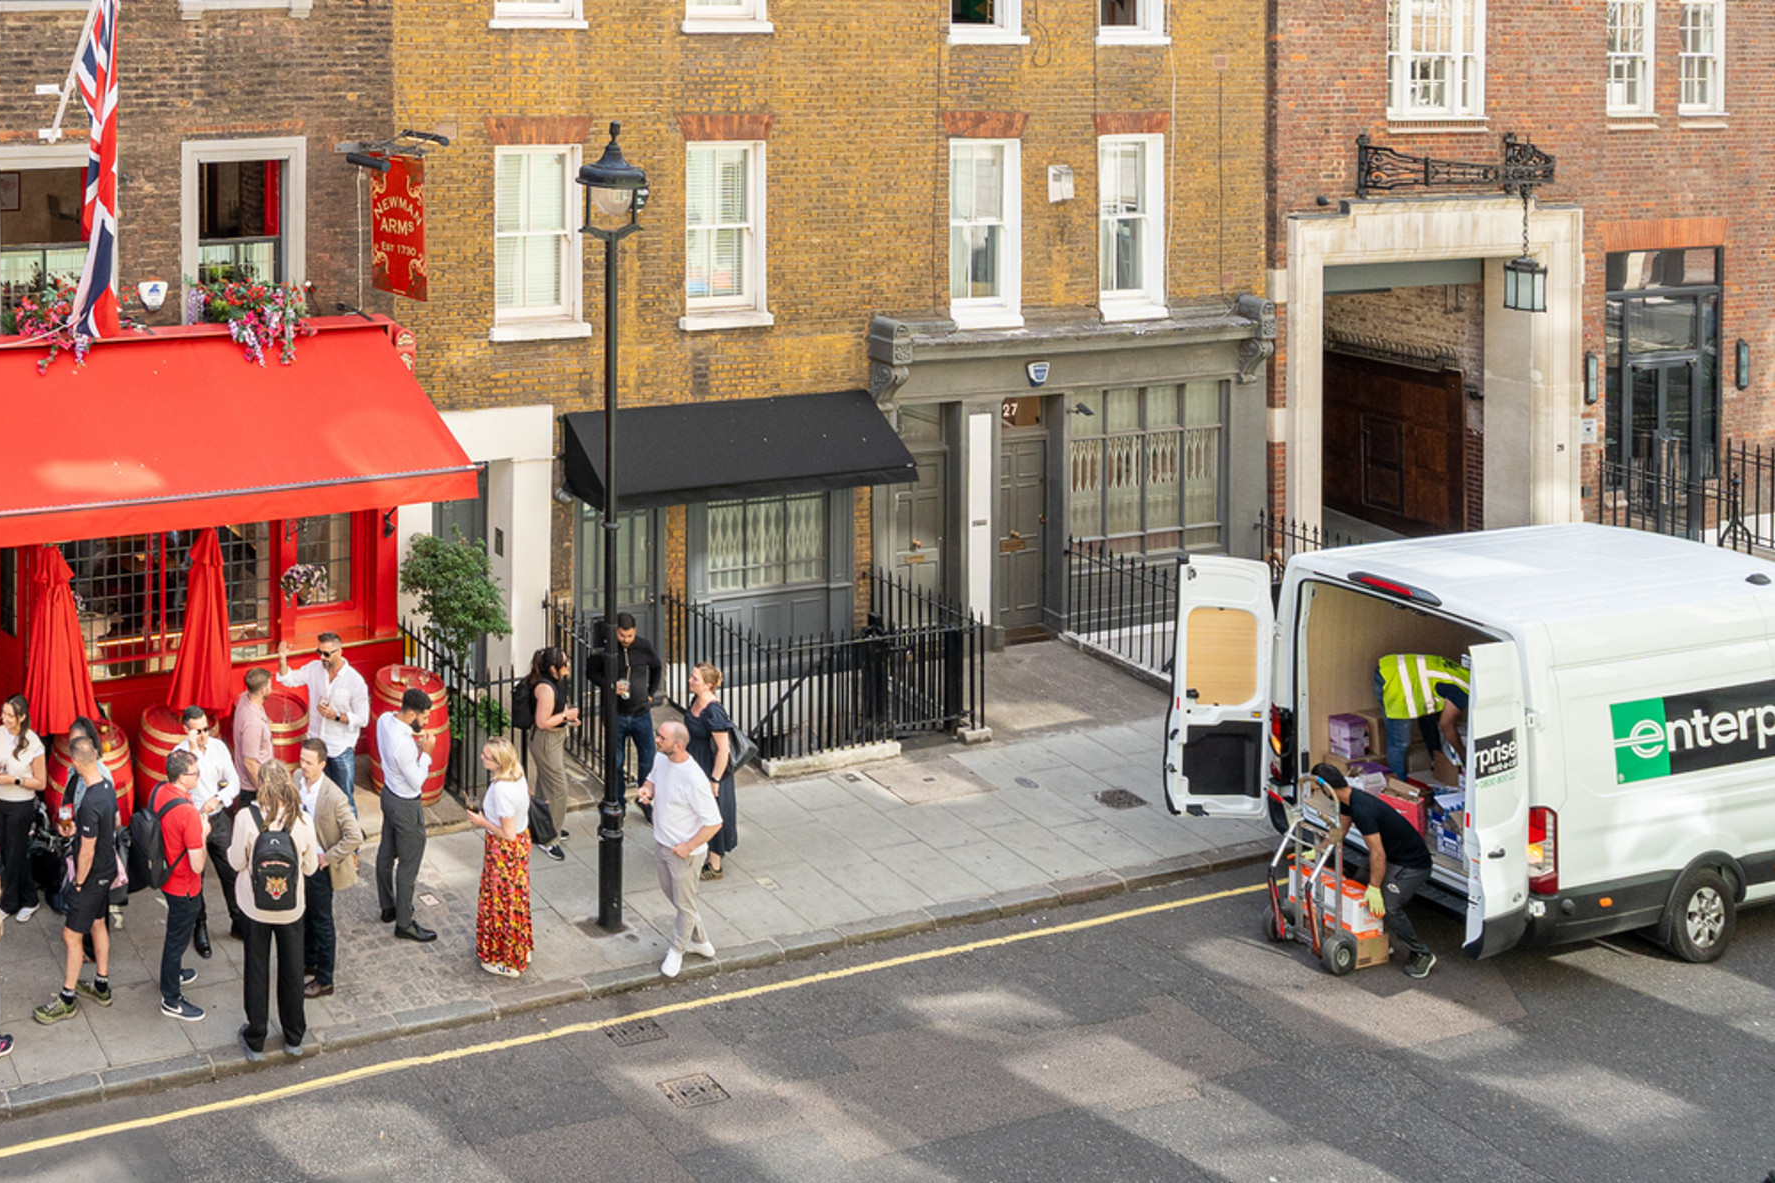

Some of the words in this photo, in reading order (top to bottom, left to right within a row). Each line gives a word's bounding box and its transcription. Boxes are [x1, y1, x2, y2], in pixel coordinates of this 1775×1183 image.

[374, 196, 423, 226] NEWMAN
[380, 217, 415, 236] ARMS
[396, 244, 417, 256] 1730
[1002, 403, 1019, 417] 27
